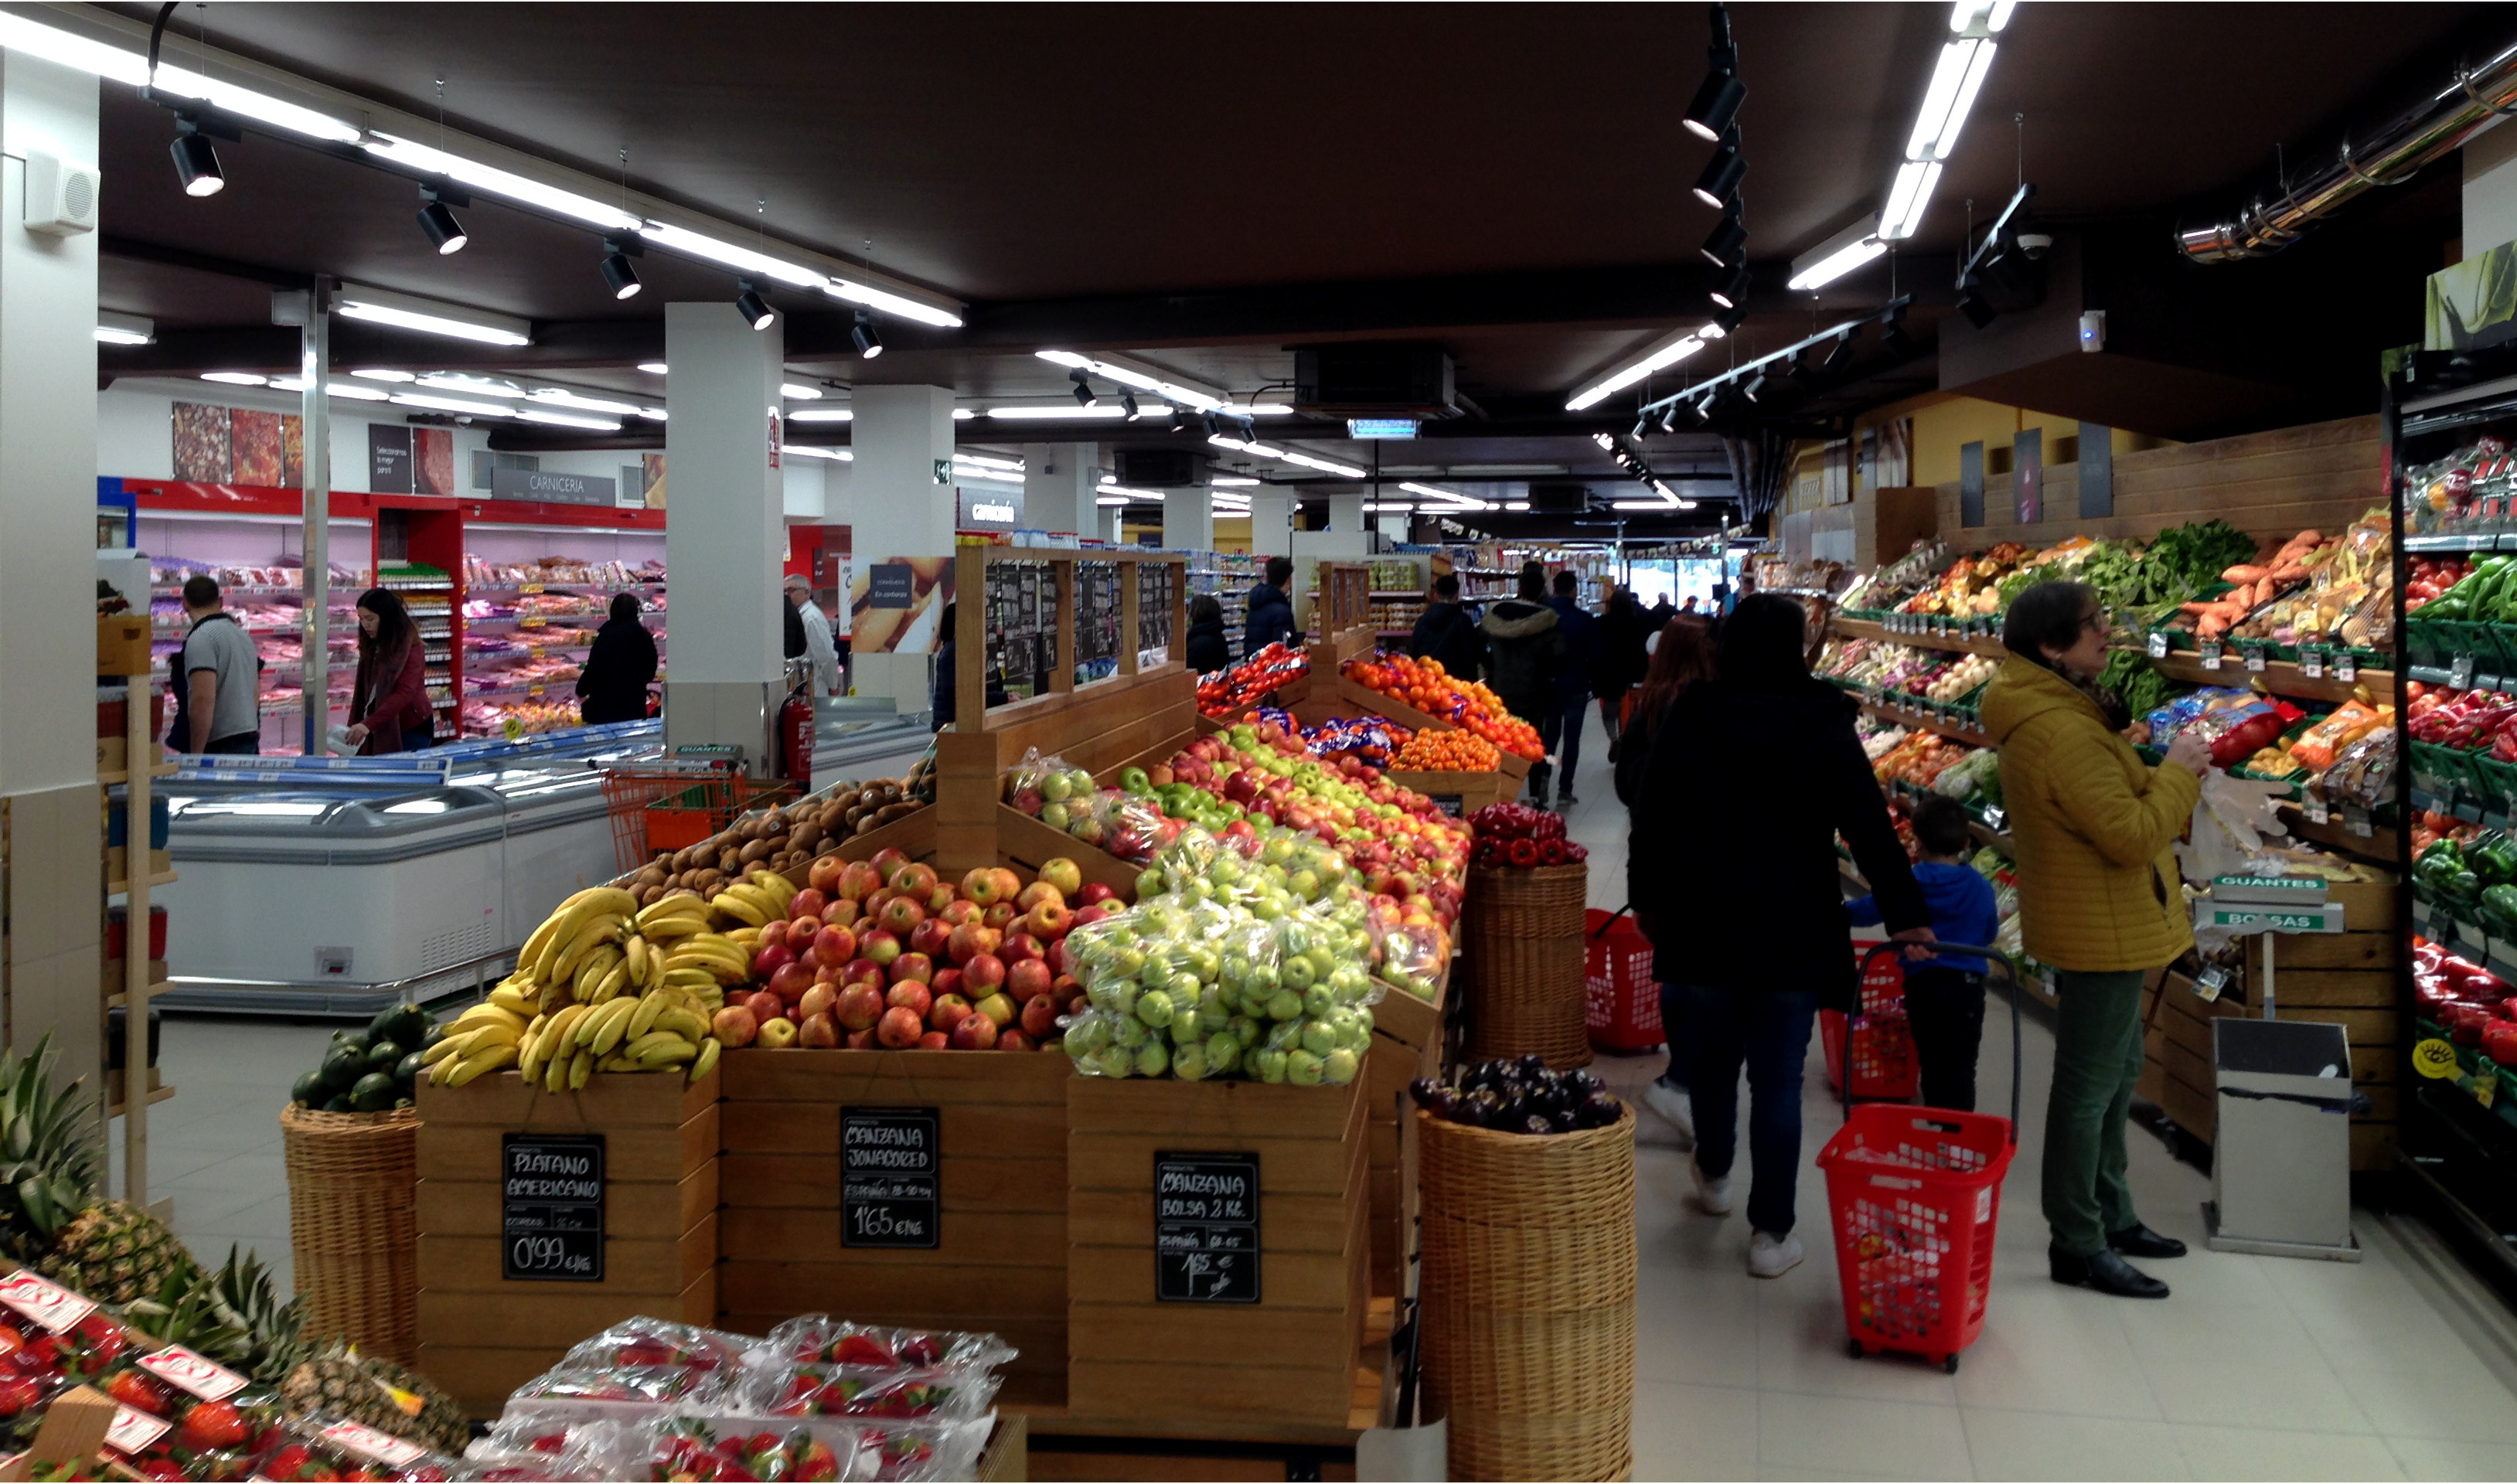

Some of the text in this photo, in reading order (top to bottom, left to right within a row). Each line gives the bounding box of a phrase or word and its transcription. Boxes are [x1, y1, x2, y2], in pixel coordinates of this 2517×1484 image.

[530, 475, 584, 494] CARNICERIA
[2221, 876, 2318, 888] GUANTES
[2228, 914, 2311, 928] BOSAS
[845, 1126, 924, 1148] MANZANA
[513, 1153, 590, 1176] PLATANO
[506, 1178, 599, 1198] AMERICANO
[1161, 1172, 1246, 1198] MANZANA
[1162, 1199, 1207, 1218] BOLSA
[1209, 1199, 1222, 1218] 2
[513, 1236, 565, 1269] 0'99
